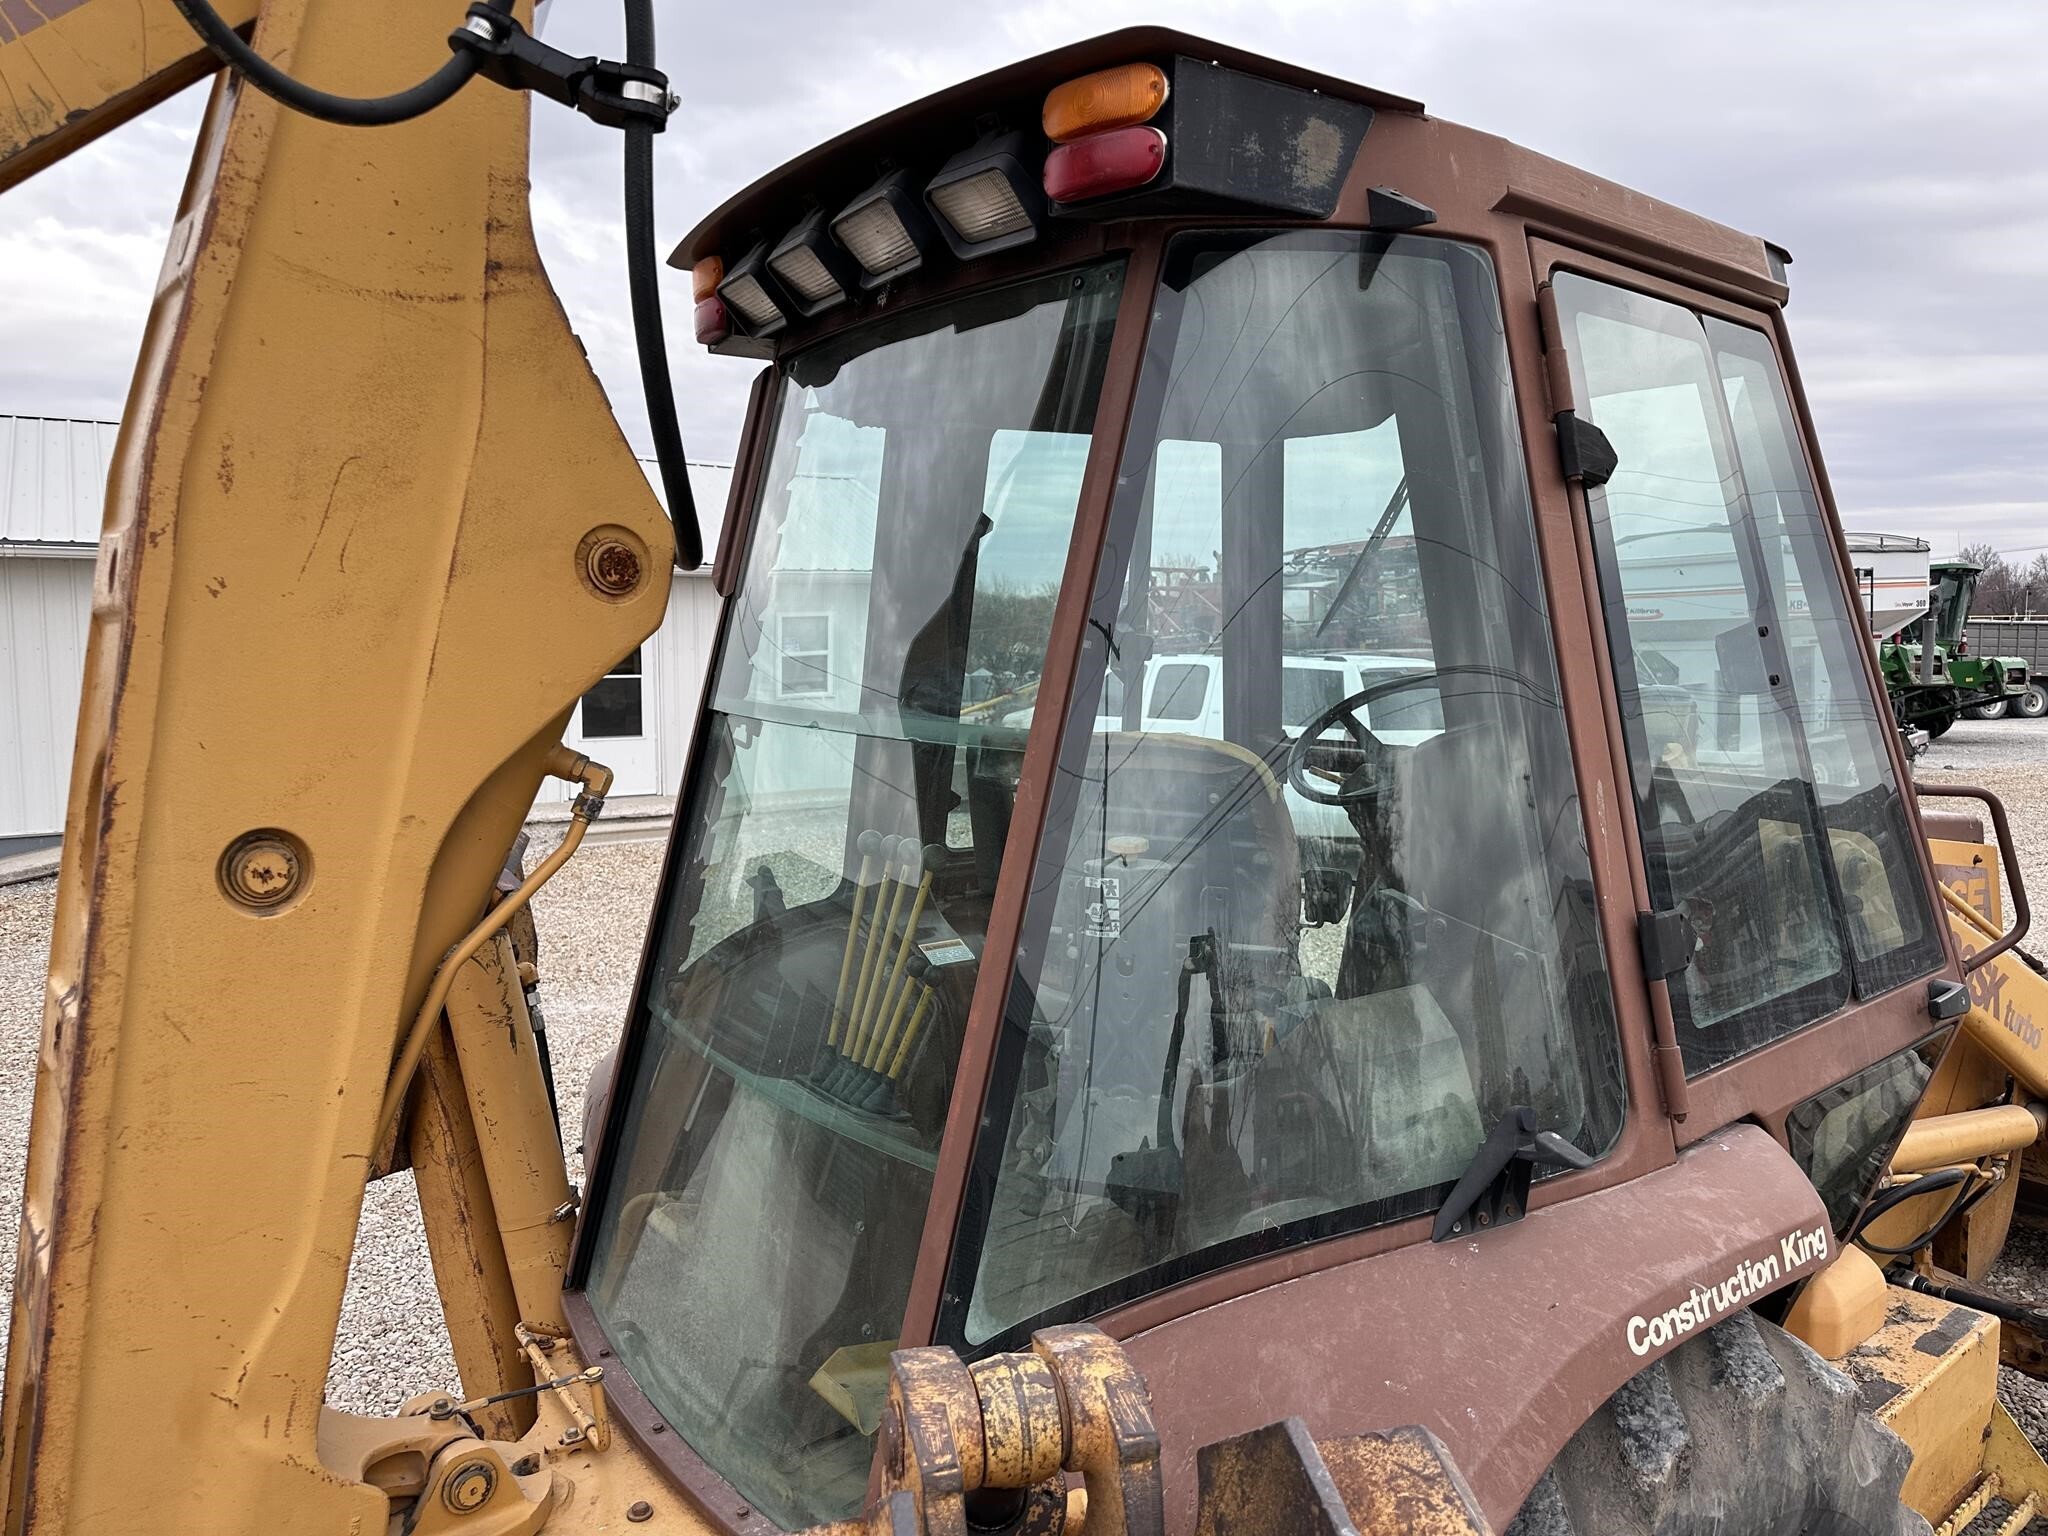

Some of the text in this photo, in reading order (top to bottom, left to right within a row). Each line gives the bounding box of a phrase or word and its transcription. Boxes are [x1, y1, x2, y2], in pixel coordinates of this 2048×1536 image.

[2003, 999, 2041, 1049] turbo
[1626, 1225, 1828, 1356] Construction King
